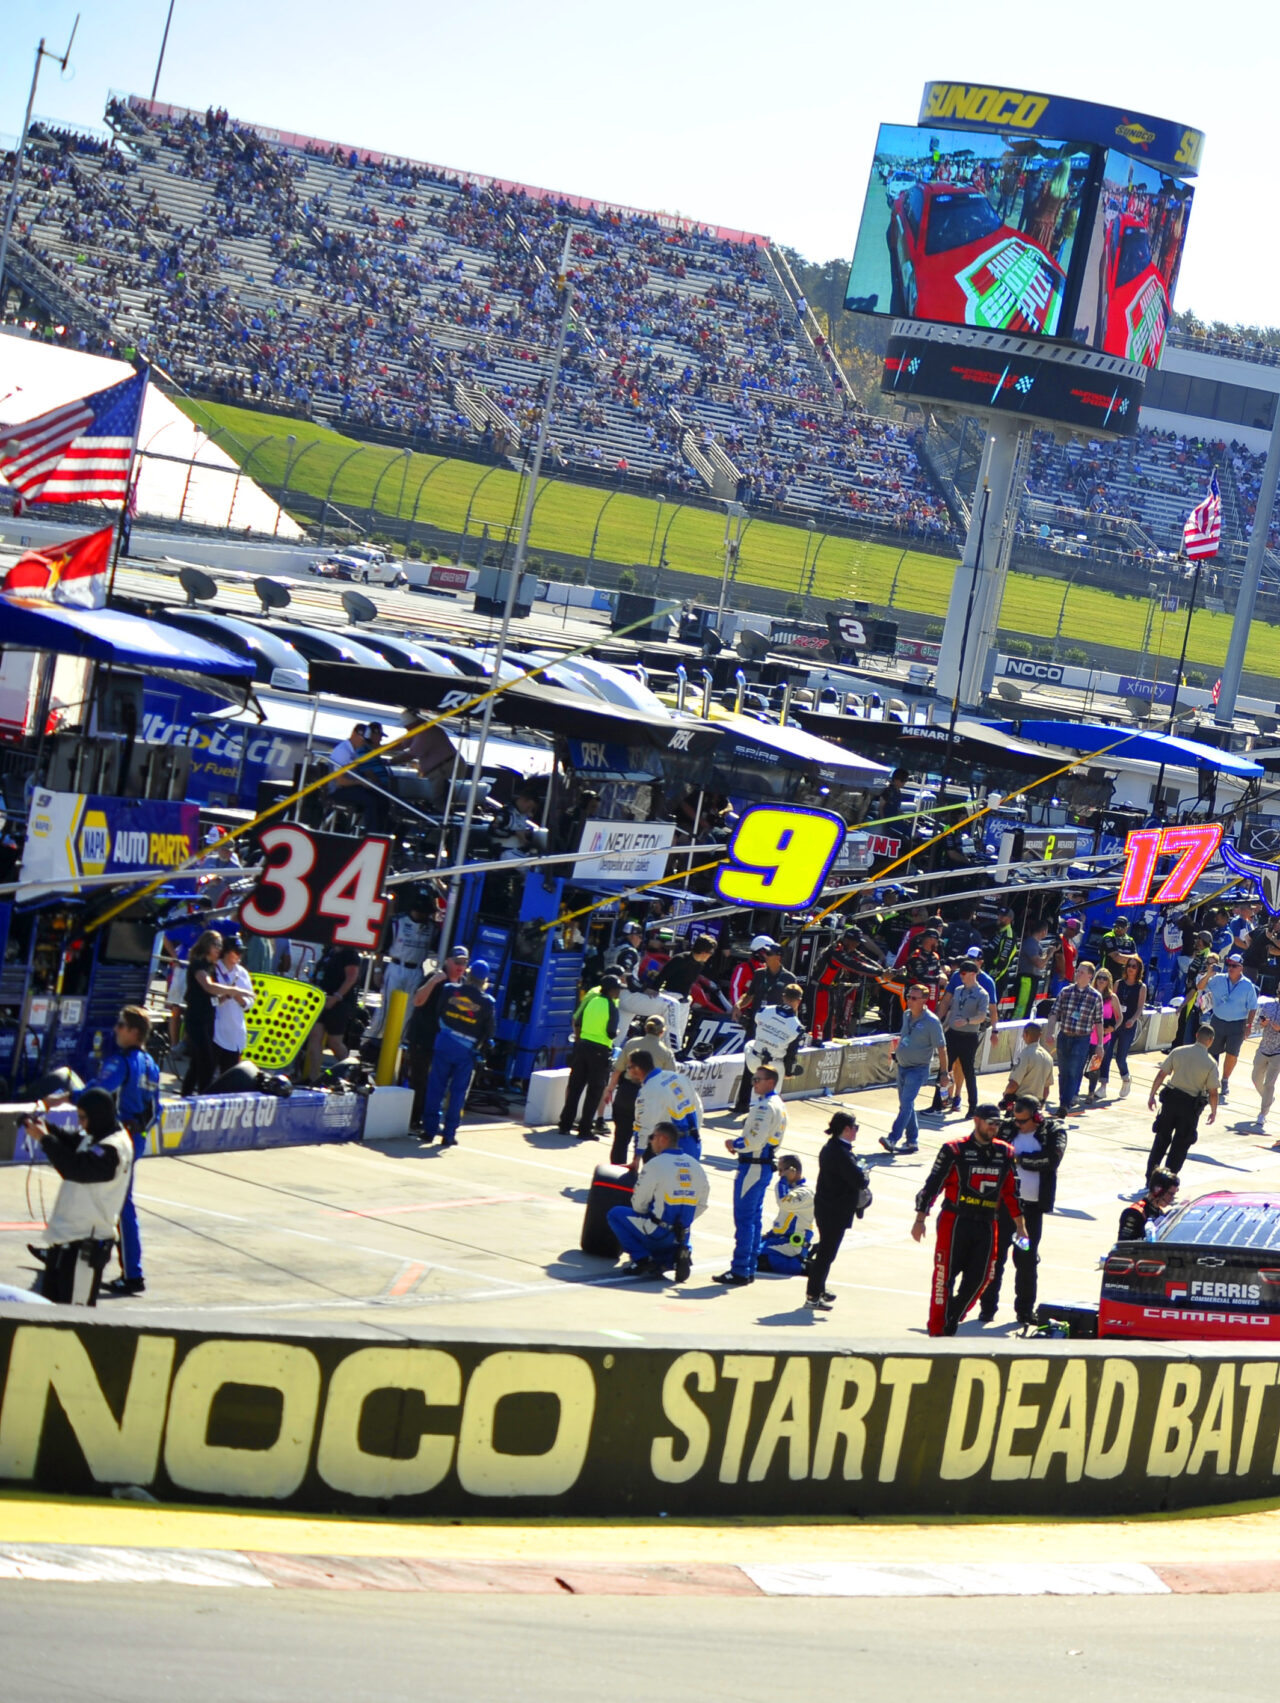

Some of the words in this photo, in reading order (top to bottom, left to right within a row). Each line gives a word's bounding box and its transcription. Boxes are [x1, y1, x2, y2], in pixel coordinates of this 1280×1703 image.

[923, 84, 1049, 128] SUNOCO
[1116, 126, 1155, 144] SUNOCO
[986, 242, 1025, 279] HUNT
[838, 618, 867, 645] 3
[1006, 659, 1062, 682] NOCO
[1126, 680, 1168, 699] xfinity
[82, 829, 105, 863] NAPA
[113, 830, 149, 864] AUTO
[148, 833, 190, 867] PARTS
[715, 804, 847, 909] 9
[1044, 835, 1056, 861] 2
[1115, 822, 1224, 907] 17
[240, 823, 390, 948] 34
[191, 1098, 219, 1132] GET
[220, 1097, 243, 1130] UP
[242, 1097, 256, 1128] &
[255, 1096, 278, 1128] GO
[971, 1166, 1000, 1176] FERRIS
[935, 1264, 945, 1306] FERRIS
[1191, 1281, 1261, 1300] FERRIS
[1190, 1295, 1230, 1306] COMMERCIAL
[1231, 1298, 1261, 1307] MOWERS
[1142, 1308, 1271, 1326] CAMARO
[0, 1325, 597, 1499] NOCO
[649, 1350, 933, 1485] START
[939, 1357, 1140, 1483] DEAD
